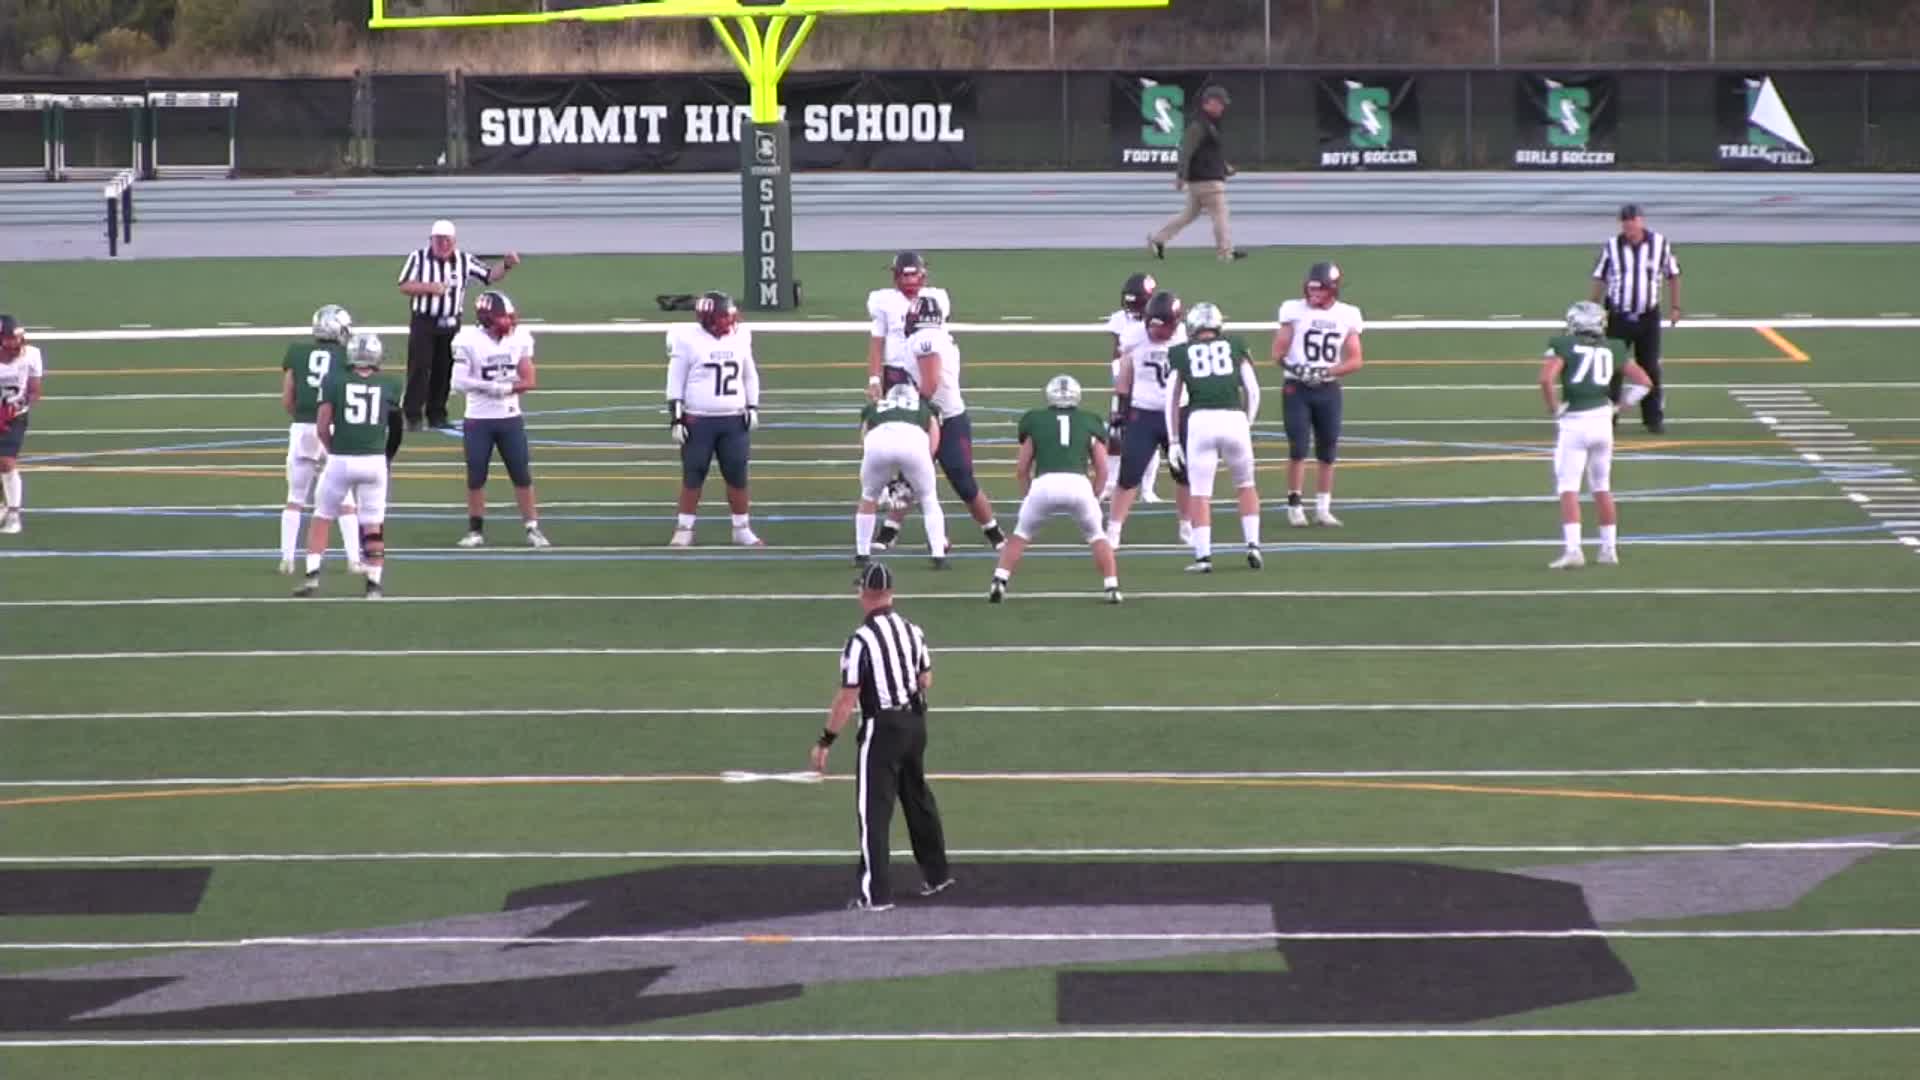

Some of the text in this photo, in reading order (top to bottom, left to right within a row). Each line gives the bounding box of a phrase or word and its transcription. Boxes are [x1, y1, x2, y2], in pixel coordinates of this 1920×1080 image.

[480, 104, 964, 146] SUMMIT HI SCHOOL
[1321, 150, 1417, 165] BOYS SOCCER
[1515, 150, 1615, 164] GIRLS SOCCER
[1719, 144, 1768, 158] TRACK
[759, 178, 779, 306] STORM
[1188, 340, 1233, 377] 88
[1304, 329, 1341, 362] 66
[306, 350, 331, 387] 9
[703, 361, 739, 396] 72
[1571, 344, 1613, 385] 70
[344, 383, 381, 425] 51
[1056, 416, 1070, 446] 1
